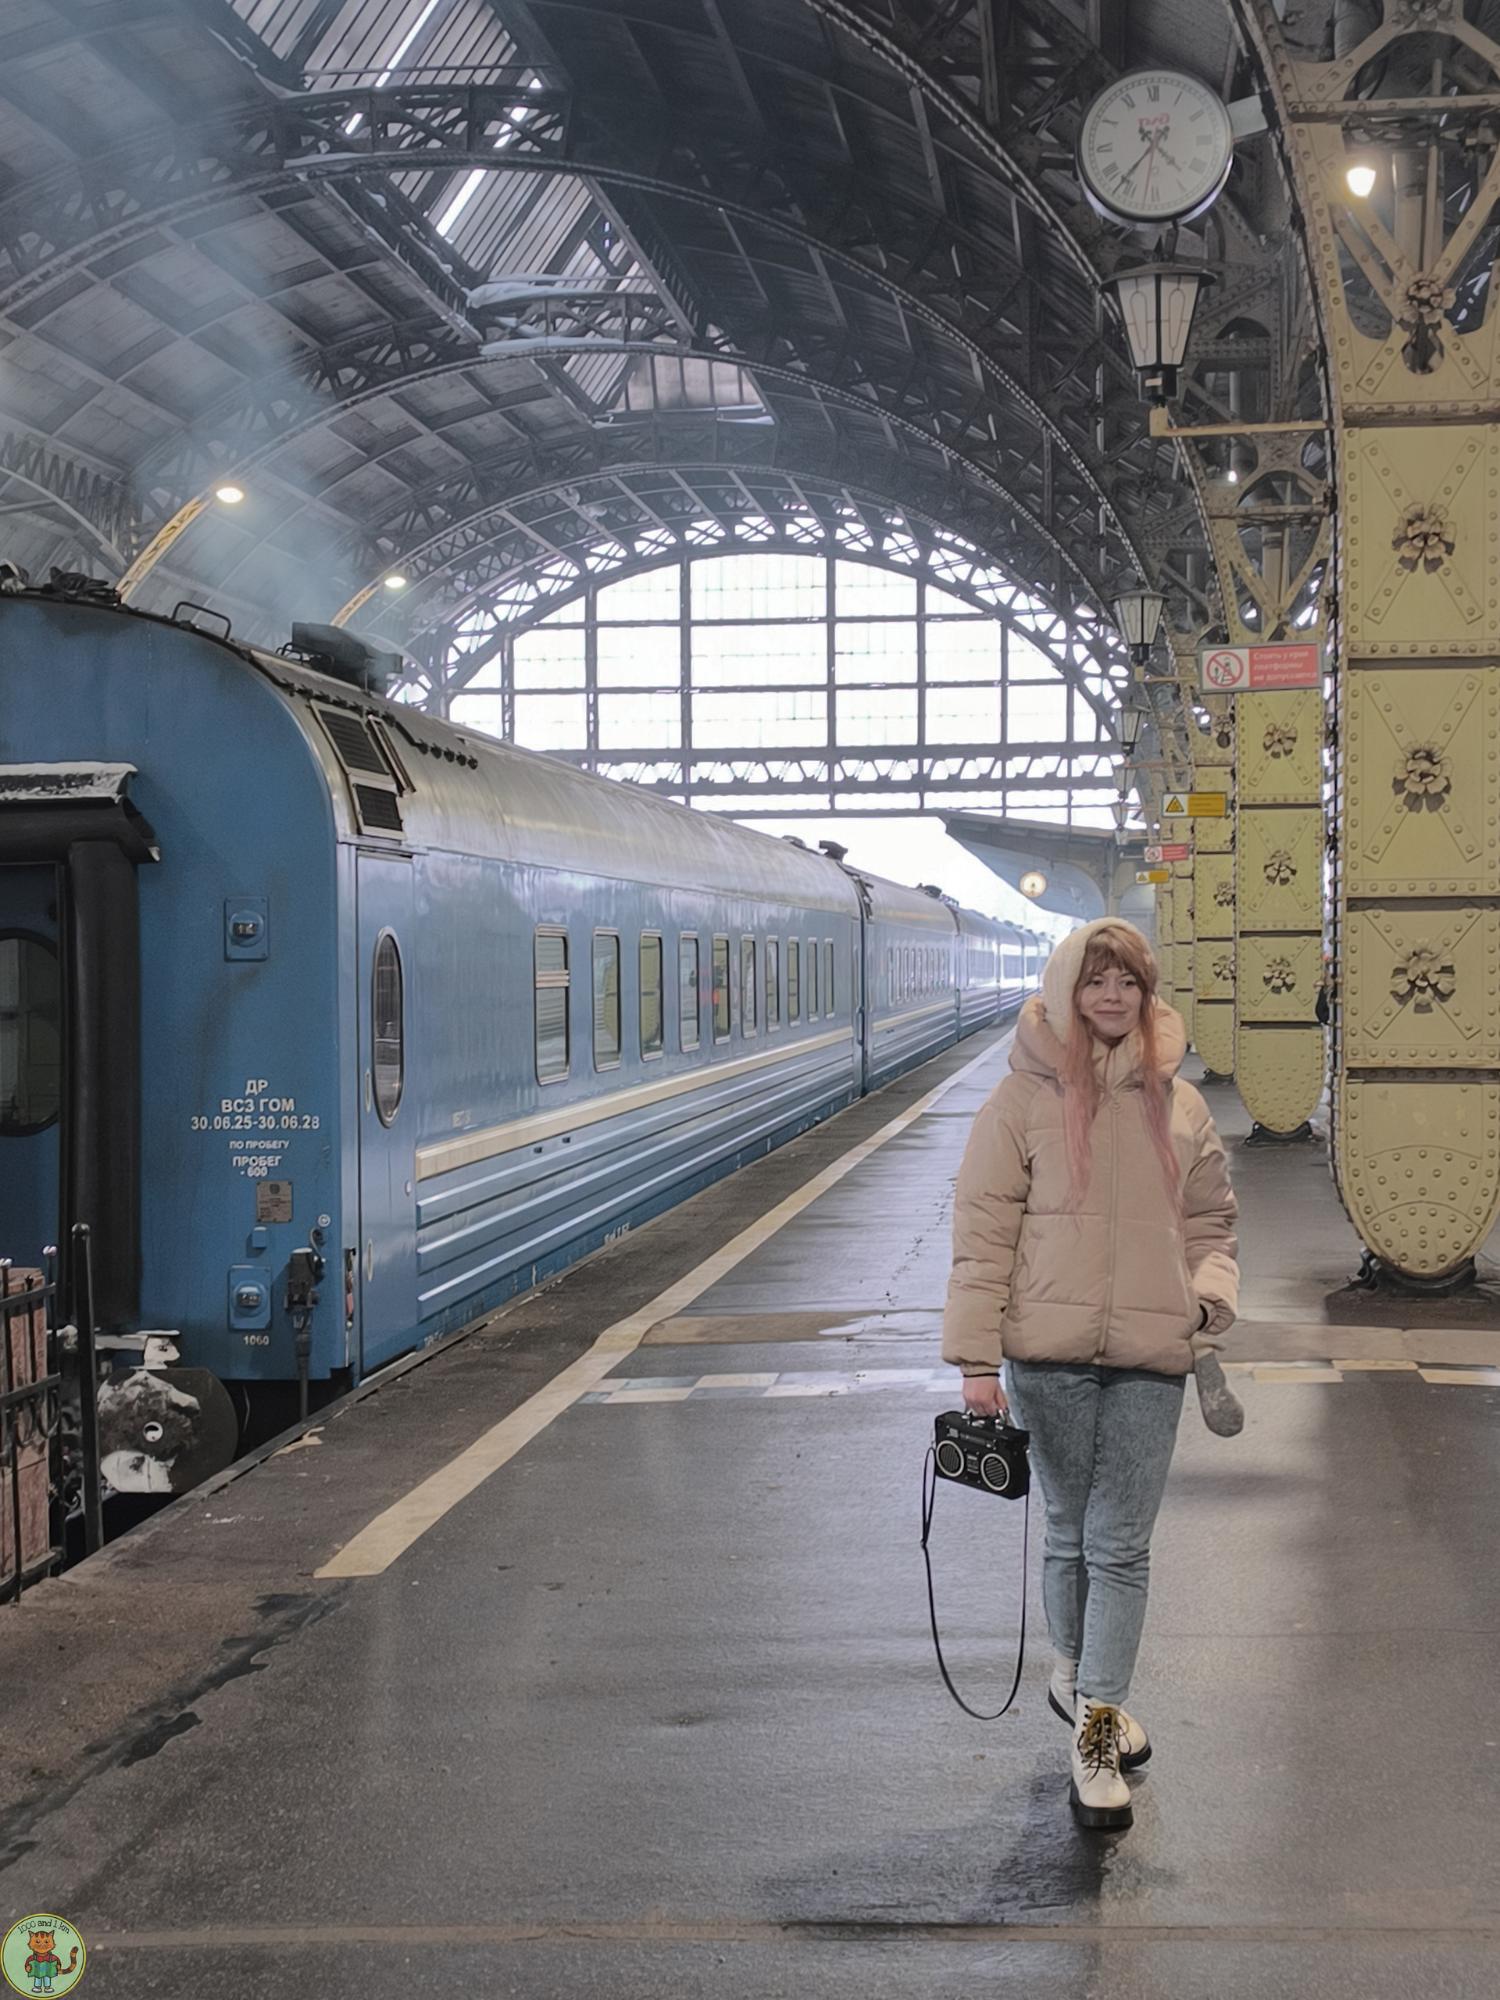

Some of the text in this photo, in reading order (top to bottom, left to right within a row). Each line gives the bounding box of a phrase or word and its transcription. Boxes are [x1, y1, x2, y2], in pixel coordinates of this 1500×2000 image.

[245, 1079, 268, 1096] ДР
[260, 1098, 295, 1112] ГОМ
[229, 1140, 290, 1150] ПО ПРОБЕГУ
[232, 1155, 282, 1168] ПРОБЕГ
